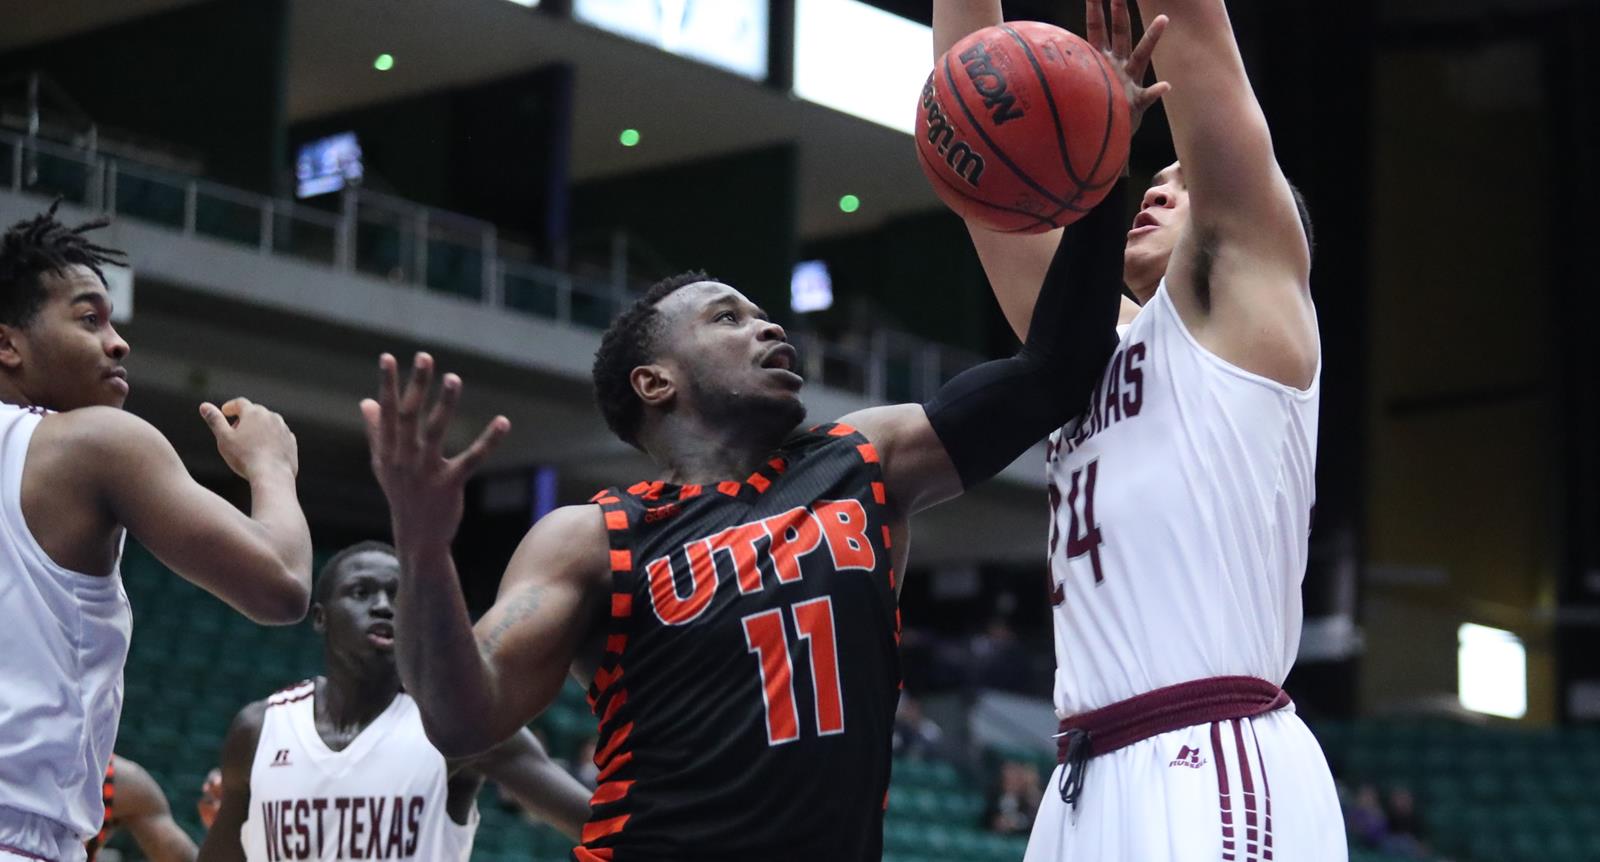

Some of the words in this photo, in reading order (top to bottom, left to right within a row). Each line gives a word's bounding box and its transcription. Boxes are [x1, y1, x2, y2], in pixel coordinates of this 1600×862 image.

[959, 42, 1025, 126] NCAA
[646, 498, 876, 625] UTPB
[741, 595, 844, 746] 11
[262, 798, 328, 862] WEST
[335, 796, 424, 860] TEXAS
